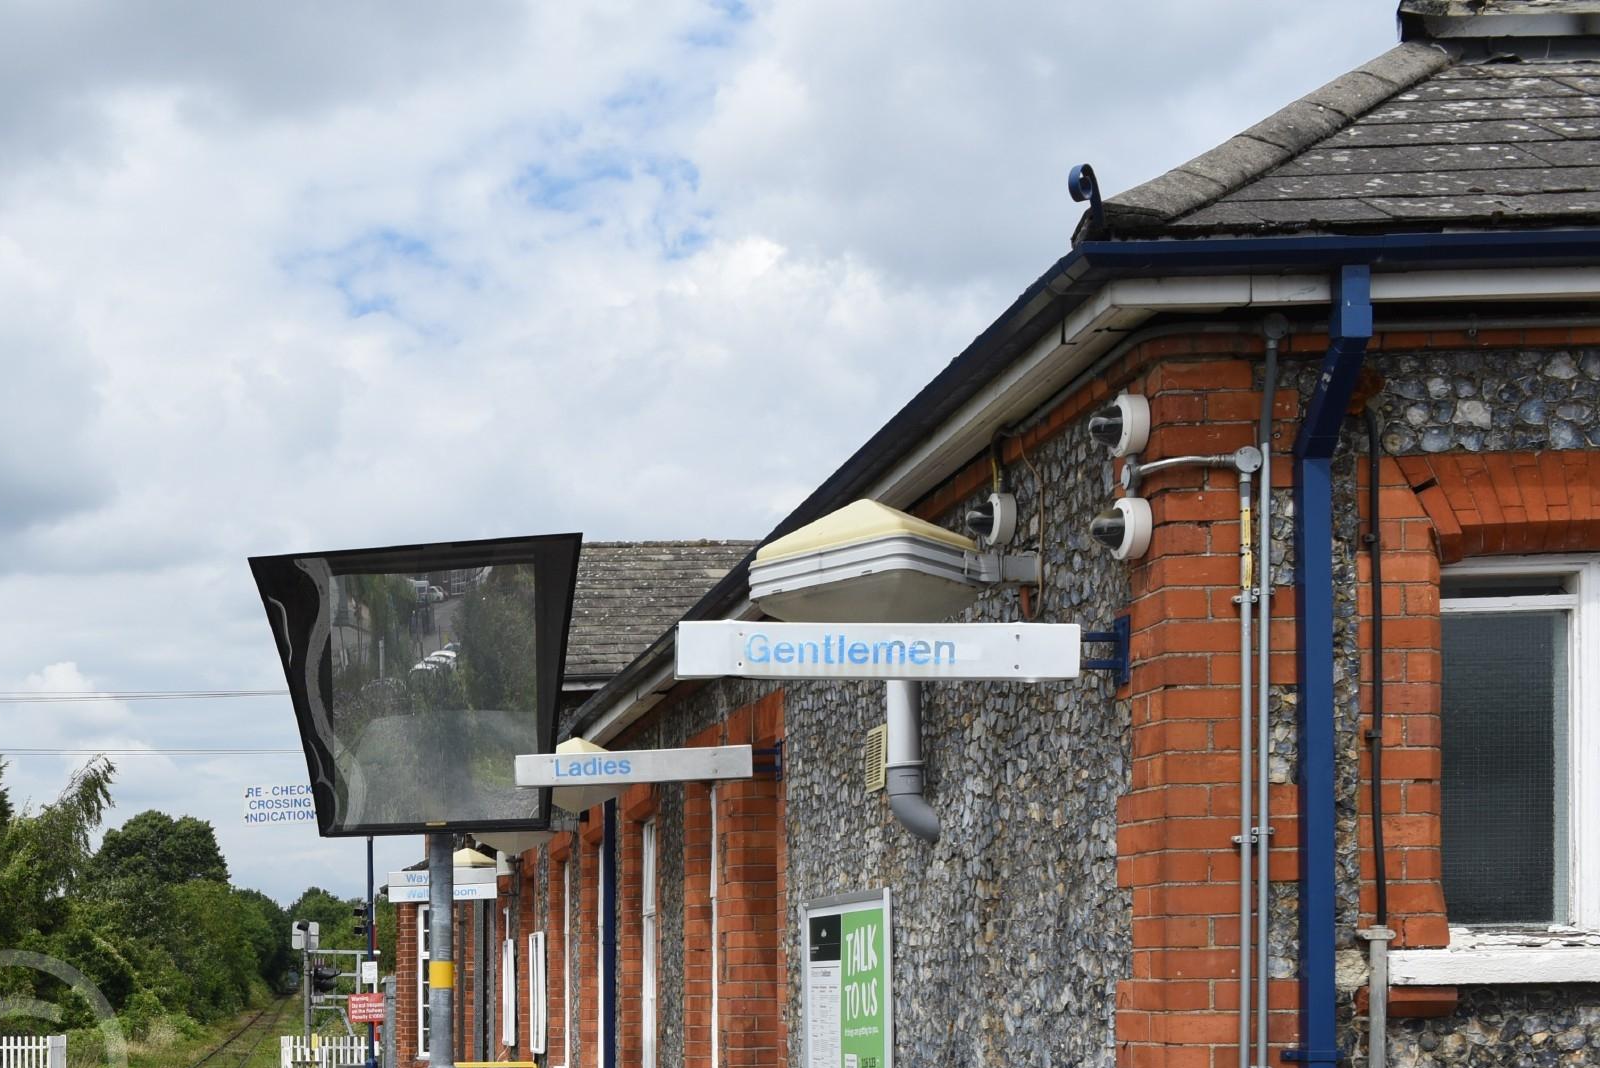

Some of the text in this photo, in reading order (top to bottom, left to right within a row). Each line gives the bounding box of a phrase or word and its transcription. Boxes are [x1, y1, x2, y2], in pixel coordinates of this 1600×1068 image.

[744, 633, 956, 665] Gentlemen
[555, 757, 631, 777] Ladies
[247, 787, 262, 797] RE
[272, 785, 313, 796] CHECK
[249, 798, 311, 810] CROSSING
[247, 810, 315, 823] INDICATION
[406, 873, 429, 884] Way
[453, 888, 477, 897] oom
[846, 924, 878, 977] TALK
[844, 976, 878, 1022] TO US
